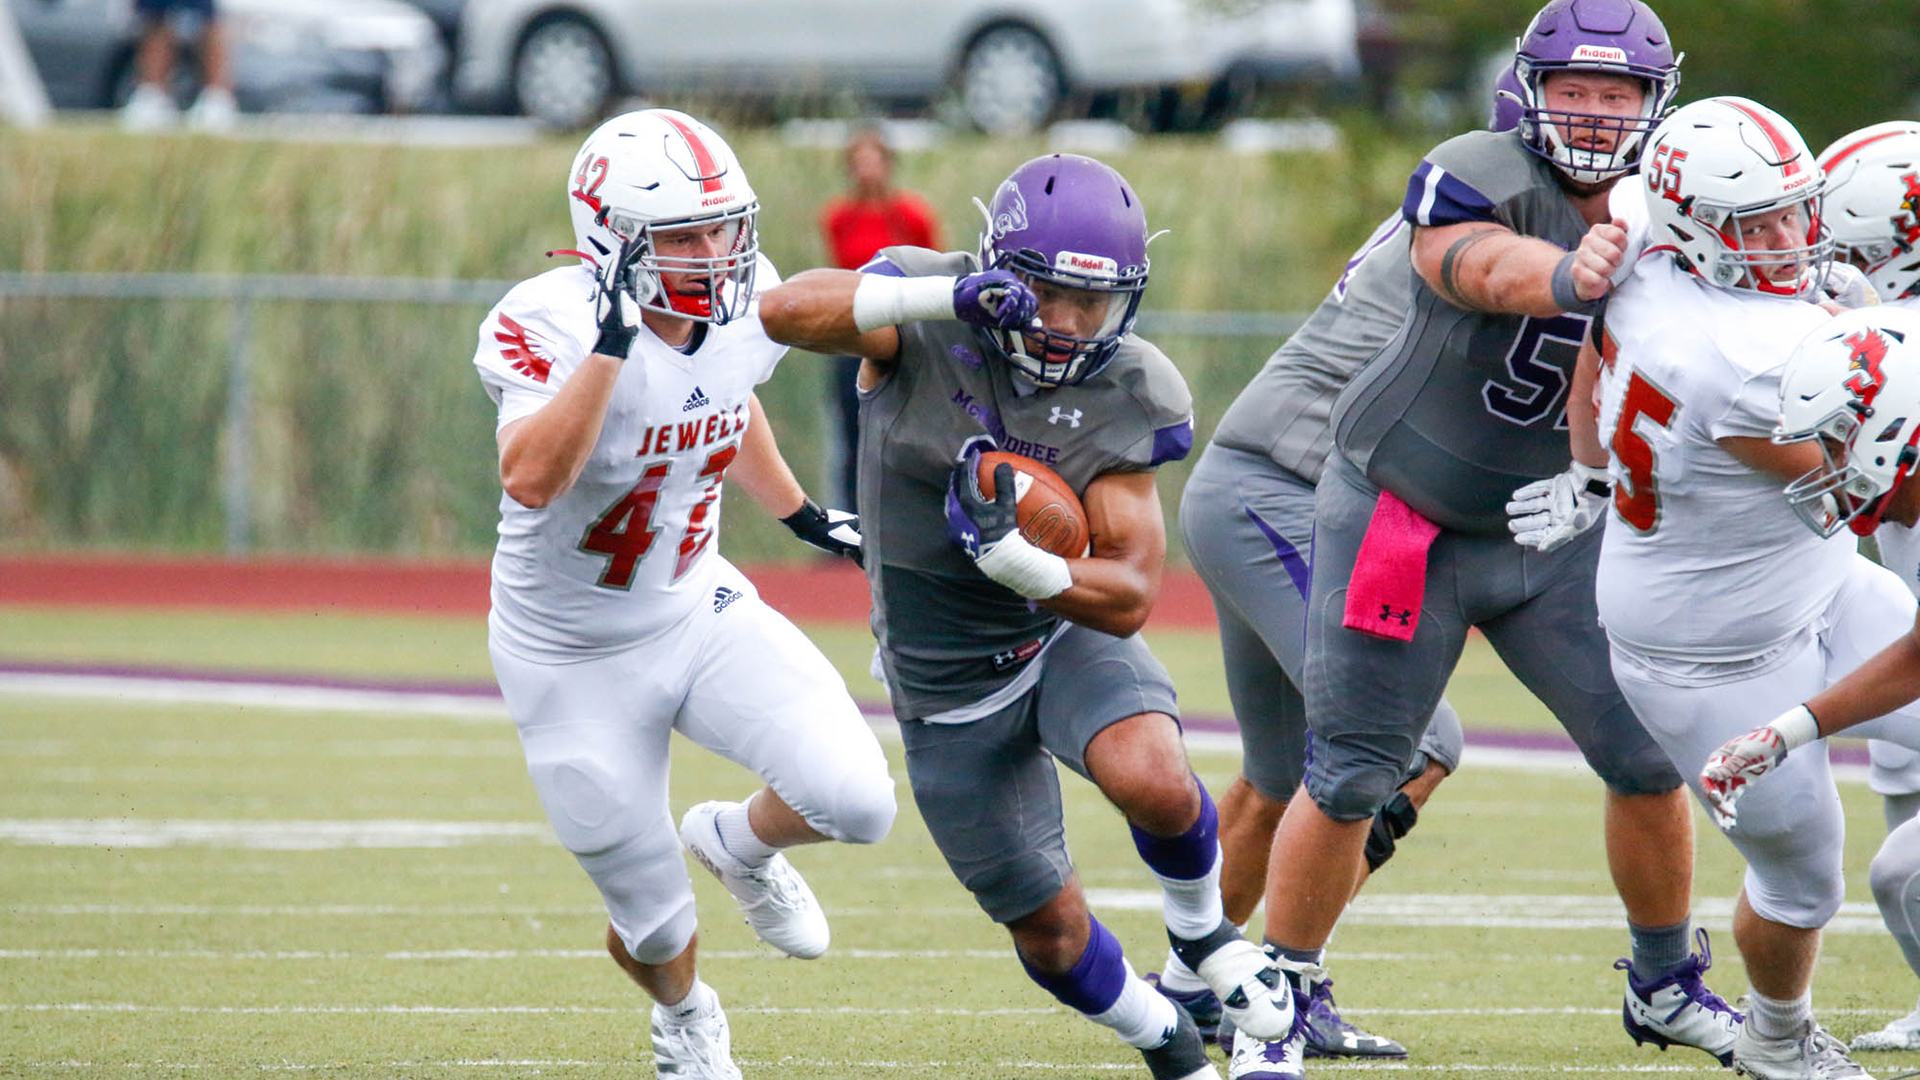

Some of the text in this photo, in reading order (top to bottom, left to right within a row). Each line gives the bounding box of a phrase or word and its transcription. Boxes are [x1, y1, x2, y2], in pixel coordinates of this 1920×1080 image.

[1579, 47, 1621, 60] Riddell
[575, 153, 609, 203] 42
[1649, 144, 1688, 195] 55
[701, 193, 736, 207] Riddell
[1070, 256, 1104, 271] Riddell
[683, 397, 710, 412] adidas
[635, 403, 744, 458] JEWELL
[714, 591, 743, 614] adidas
